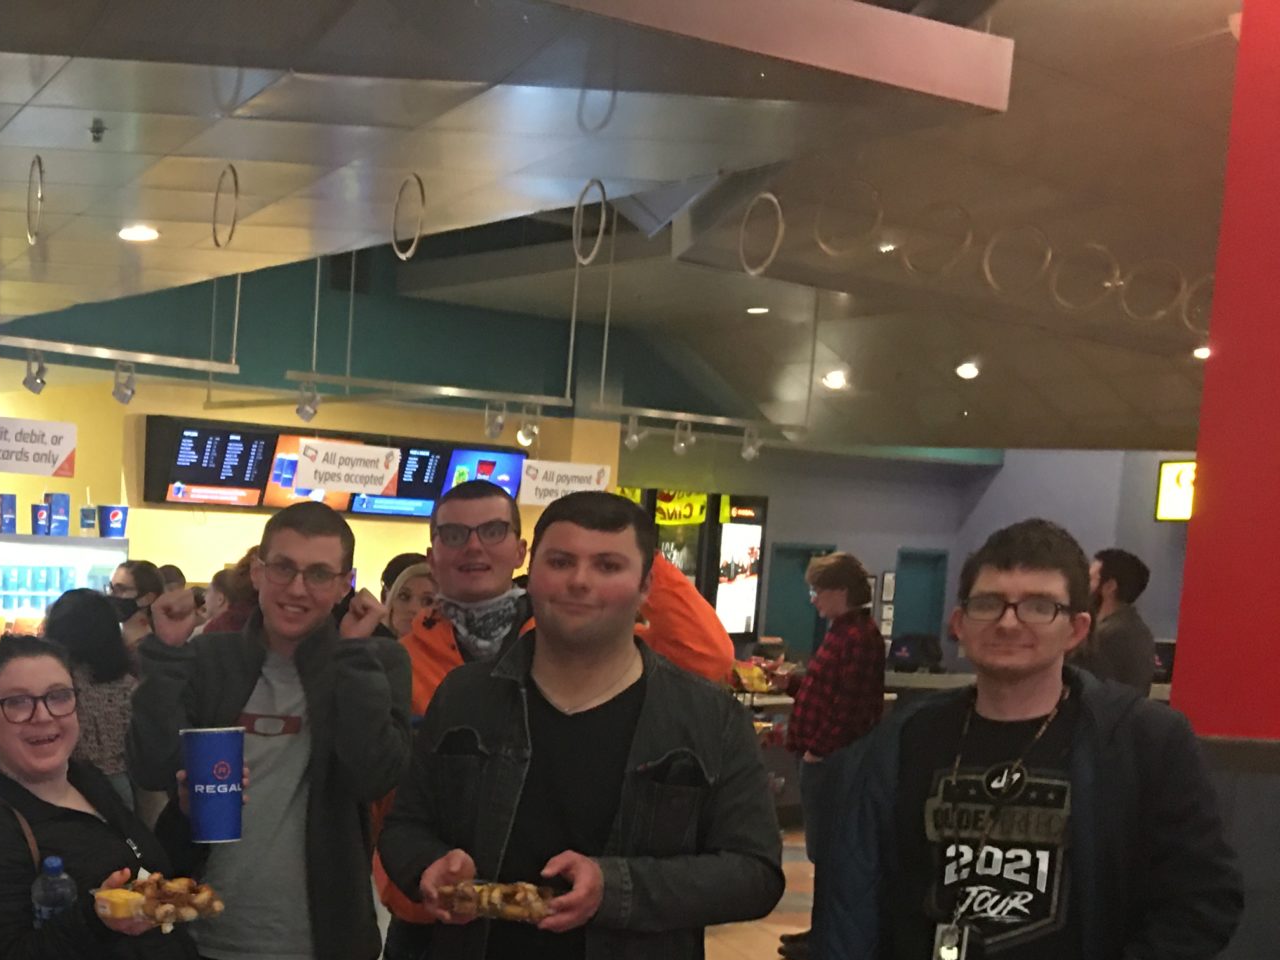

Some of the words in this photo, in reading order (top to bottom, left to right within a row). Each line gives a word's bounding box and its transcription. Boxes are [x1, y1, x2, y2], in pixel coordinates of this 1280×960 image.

[14, 428, 47, 445] debit,
[51, 433, 64, 446] or
[32, 449, 59, 467] only
[321, 451, 336, 465] All
[338, 455, 380, 470] payment
[313, 469, 342, 484] types
[344, 472, 384, 487] accepted
[542, 470, 554, 482] All
[556, 472, 593, 485] payment
[535, 486, 558, 499] types
[195, 784, 242, 794] REGAL
[944, 843, 1050, 894] 2021
[958, 885, 1034, 917] TOUR
